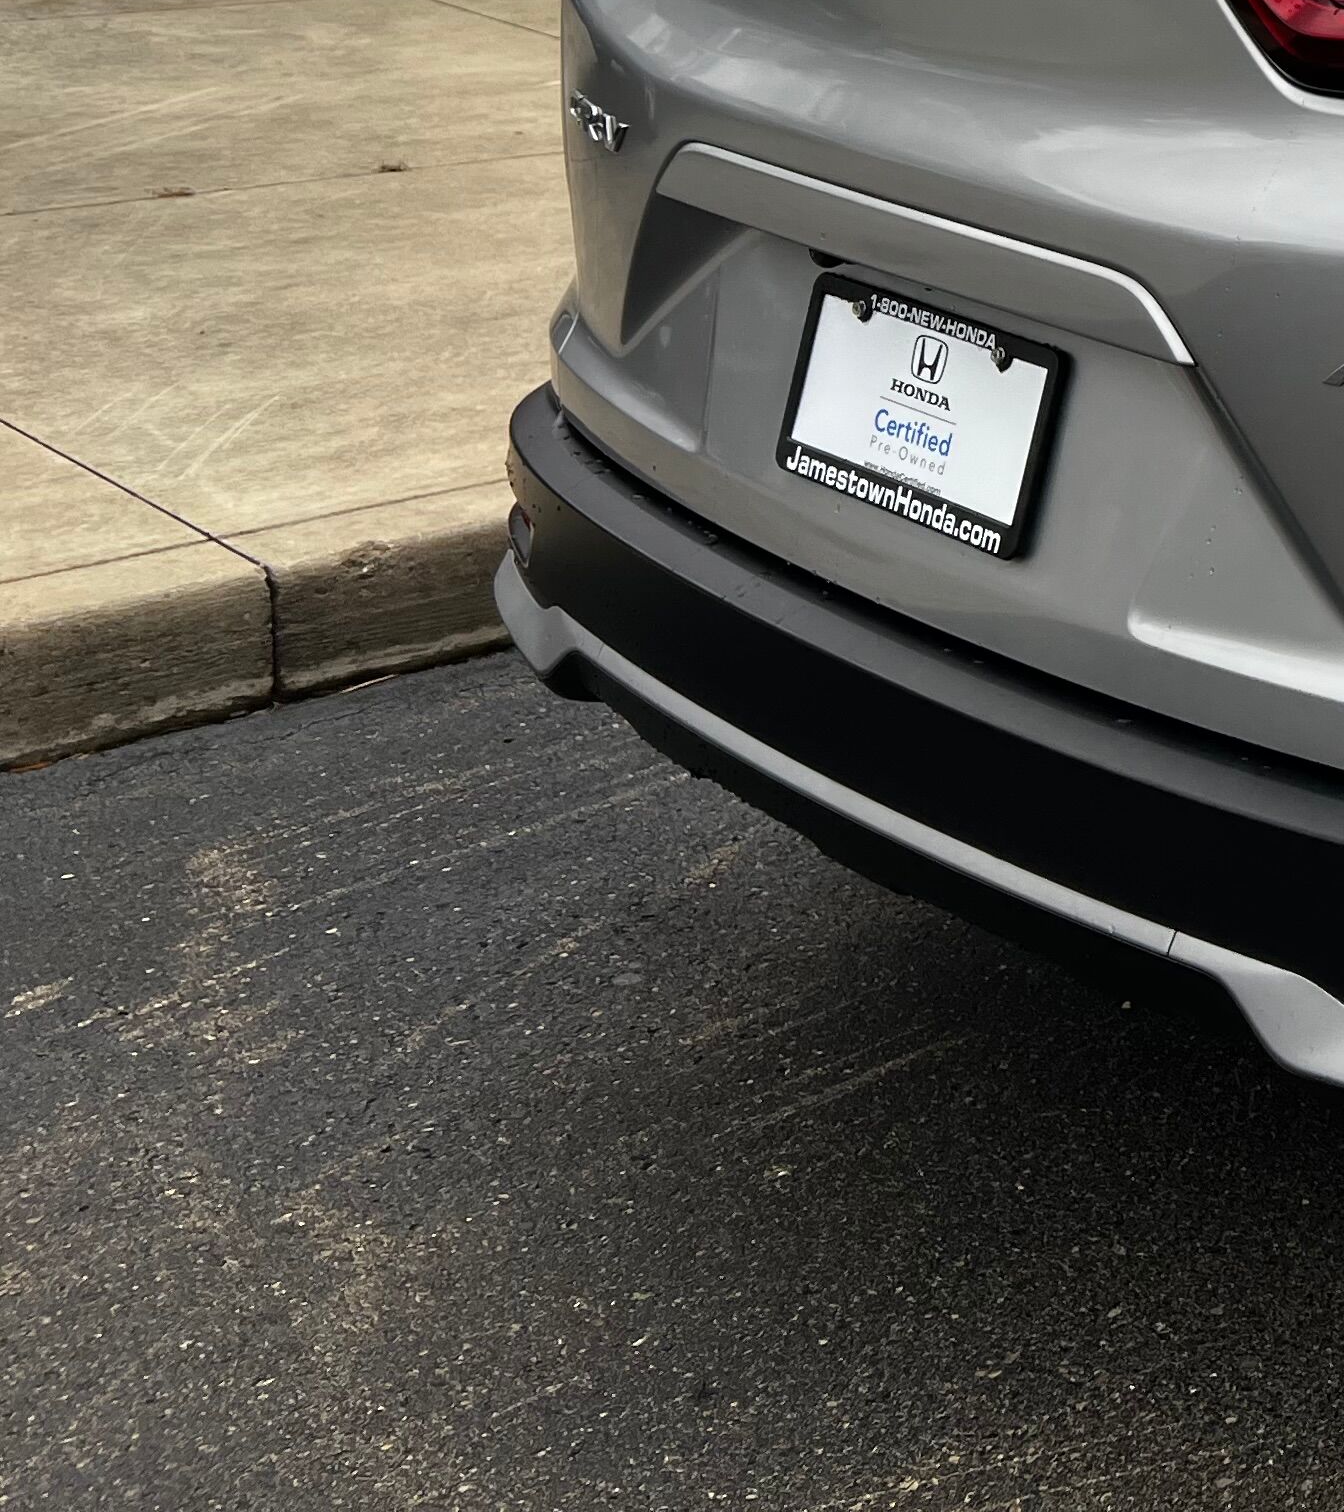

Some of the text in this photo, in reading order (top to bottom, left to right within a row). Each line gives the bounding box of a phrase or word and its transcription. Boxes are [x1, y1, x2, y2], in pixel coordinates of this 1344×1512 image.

[870, 294, 997, 350] 1-800-NEW-HONDA
[890, 378, 951, 411] HONDA
[869, 434, 947, 476] Pre-Owned
[874, 408, 953, 457] Certified
[786, 445, 1002, 555] JamestownHonda.com
